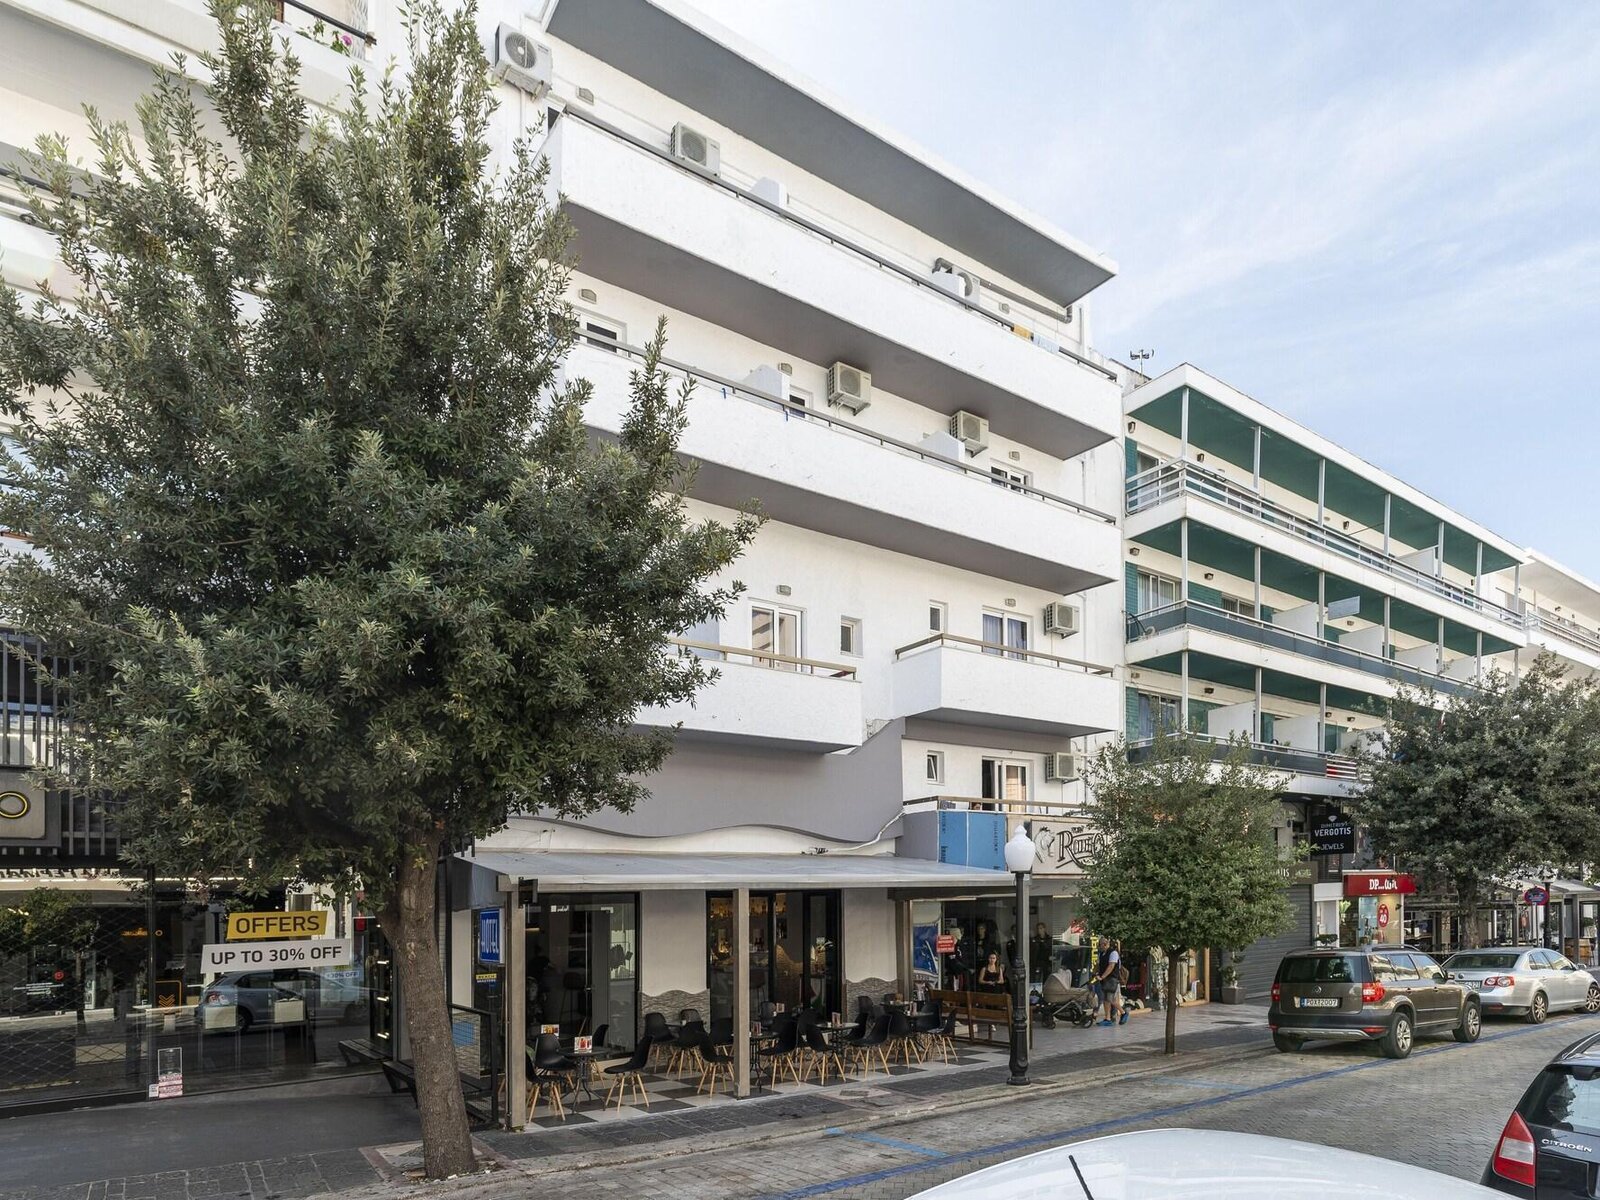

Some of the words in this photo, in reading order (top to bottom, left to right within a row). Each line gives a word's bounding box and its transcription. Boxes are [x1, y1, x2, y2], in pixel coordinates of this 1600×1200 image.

[1314, 827, 1352, 837] VERGOTIS
[236, 915, 320, 934] OFFERS
[211, 951, 236, 965] UP
[241, 950, 263, 963] TO
[269, 947, 305, 962] 30%
[310, 946, 342, 959] OFF
[1541, 1138, 1593, 1153] CITROËN
